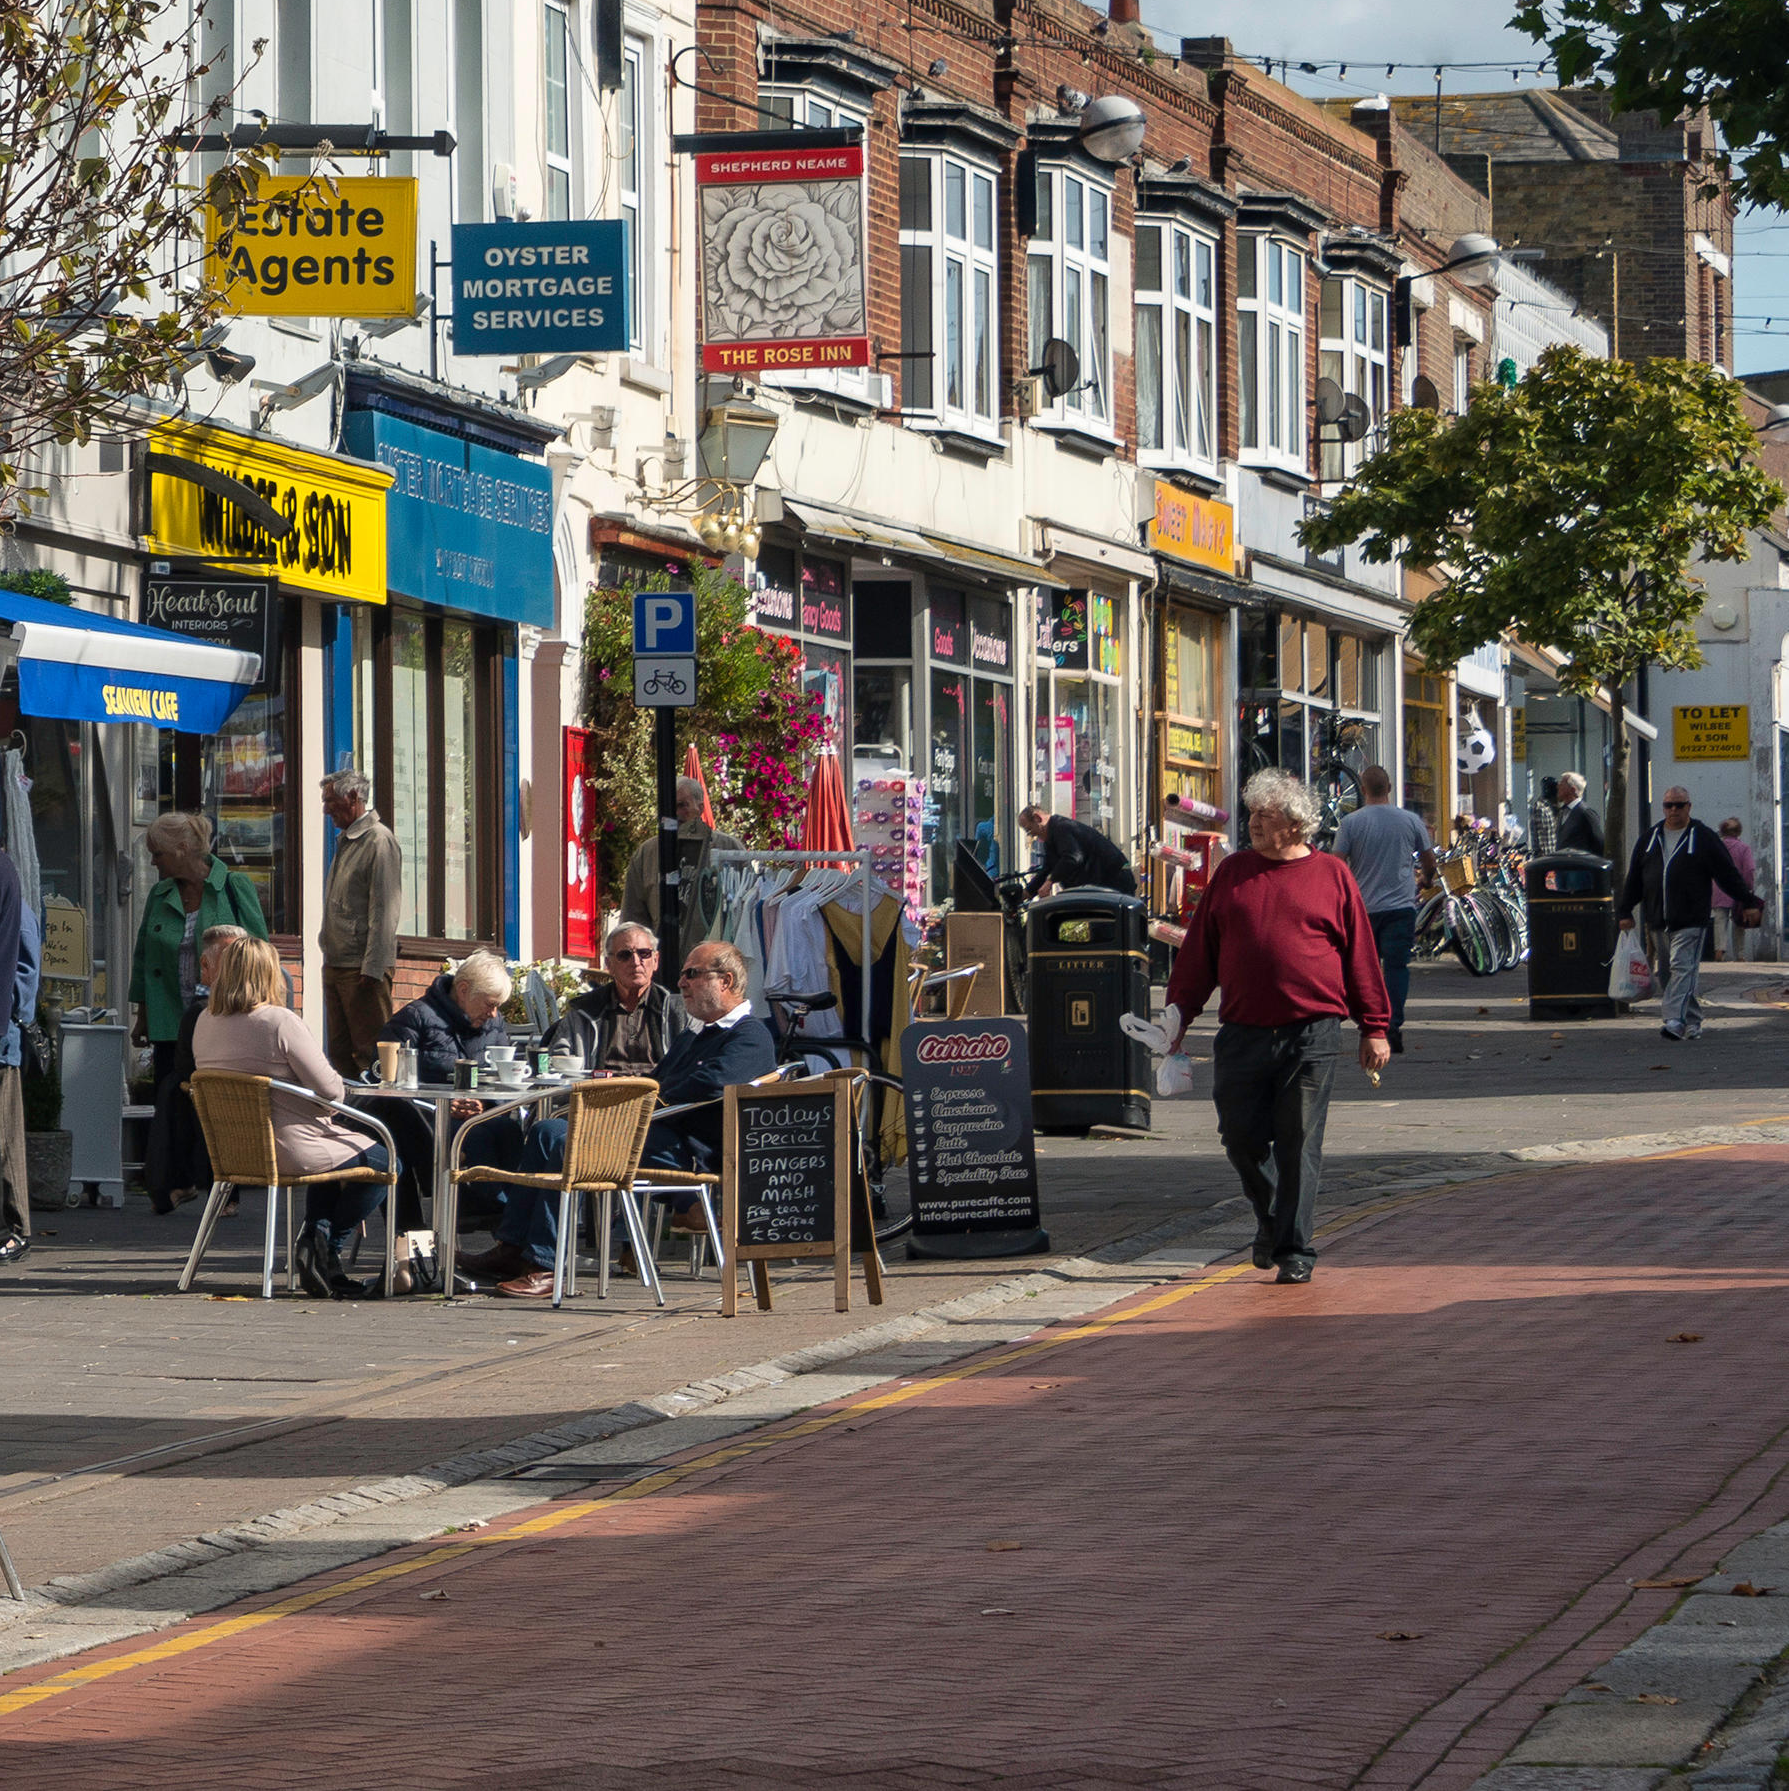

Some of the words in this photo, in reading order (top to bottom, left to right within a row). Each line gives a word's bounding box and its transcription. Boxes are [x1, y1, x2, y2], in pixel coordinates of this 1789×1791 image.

[711, 160, 791, 174] SHEPHERD
[796, 158, 847, 170] NEAME
[237, 199, 384, 238] Estate
[484, 245, 590, 268] OYSTER
[230, 246, 395, 297] Agents
[462, 276, 614, 299] MORTGAGE
[472, 308, 605, 331] SERVICES
[719, 350, 758, 365] THE
[764, 347, 814, 364] ROSE
[820, 345, 852, 361] INN
[426, 458, 493, 521] MORTGAGE
[493, 478, 552, 536] SERVICES
[303, 490, 353, 579] SON
[146, 585, 206, 622] Heart
[209, 589, 259, 619] Soul
[171, 620, 229, 632] INTERIORS
[645, 598, 685, 649] P
[820, 600, 842, 633] Goods
[934, 627, 954, 657] Goods
[102, 684, 152, 719] SEAVIEW
[152, 690, 179, 722] CAFE
[1679, 707, 1703, 719] TO
[1709, 707, 1741, 719] LET
[1705, 734, 1728, 742] SON
[1058, 960, 1105, 969] LITTER
[930, 1087, 986, 1104] Espresso
[743, 1104, 831, 1130] Todays
[931, 1104, 998, 1118] Americano
[932, 1119, 1005, 1137] Cappuccino
[746, 1130, 822, 1149] Special
[933, 1136, 968, 1150] Latte
[749, 1155, 827, 1175] BANGERS
[935, 1152, 962, 1168] Hot
[962, 1149, 1023, 1166] Chocolate
[768, 1174, 805, 1186] AND
[999, 1166, 1029, 1180] Teas
[760, 1185, 816, 1203] MASH
[918, 1195, 1031, 1211] www.purecaffe.com
[774, 1204, 800, 1214] tea
[803, 1204, 820, 1213] or
[920, 1207, 1032, 1222] info@purecaffe.com
